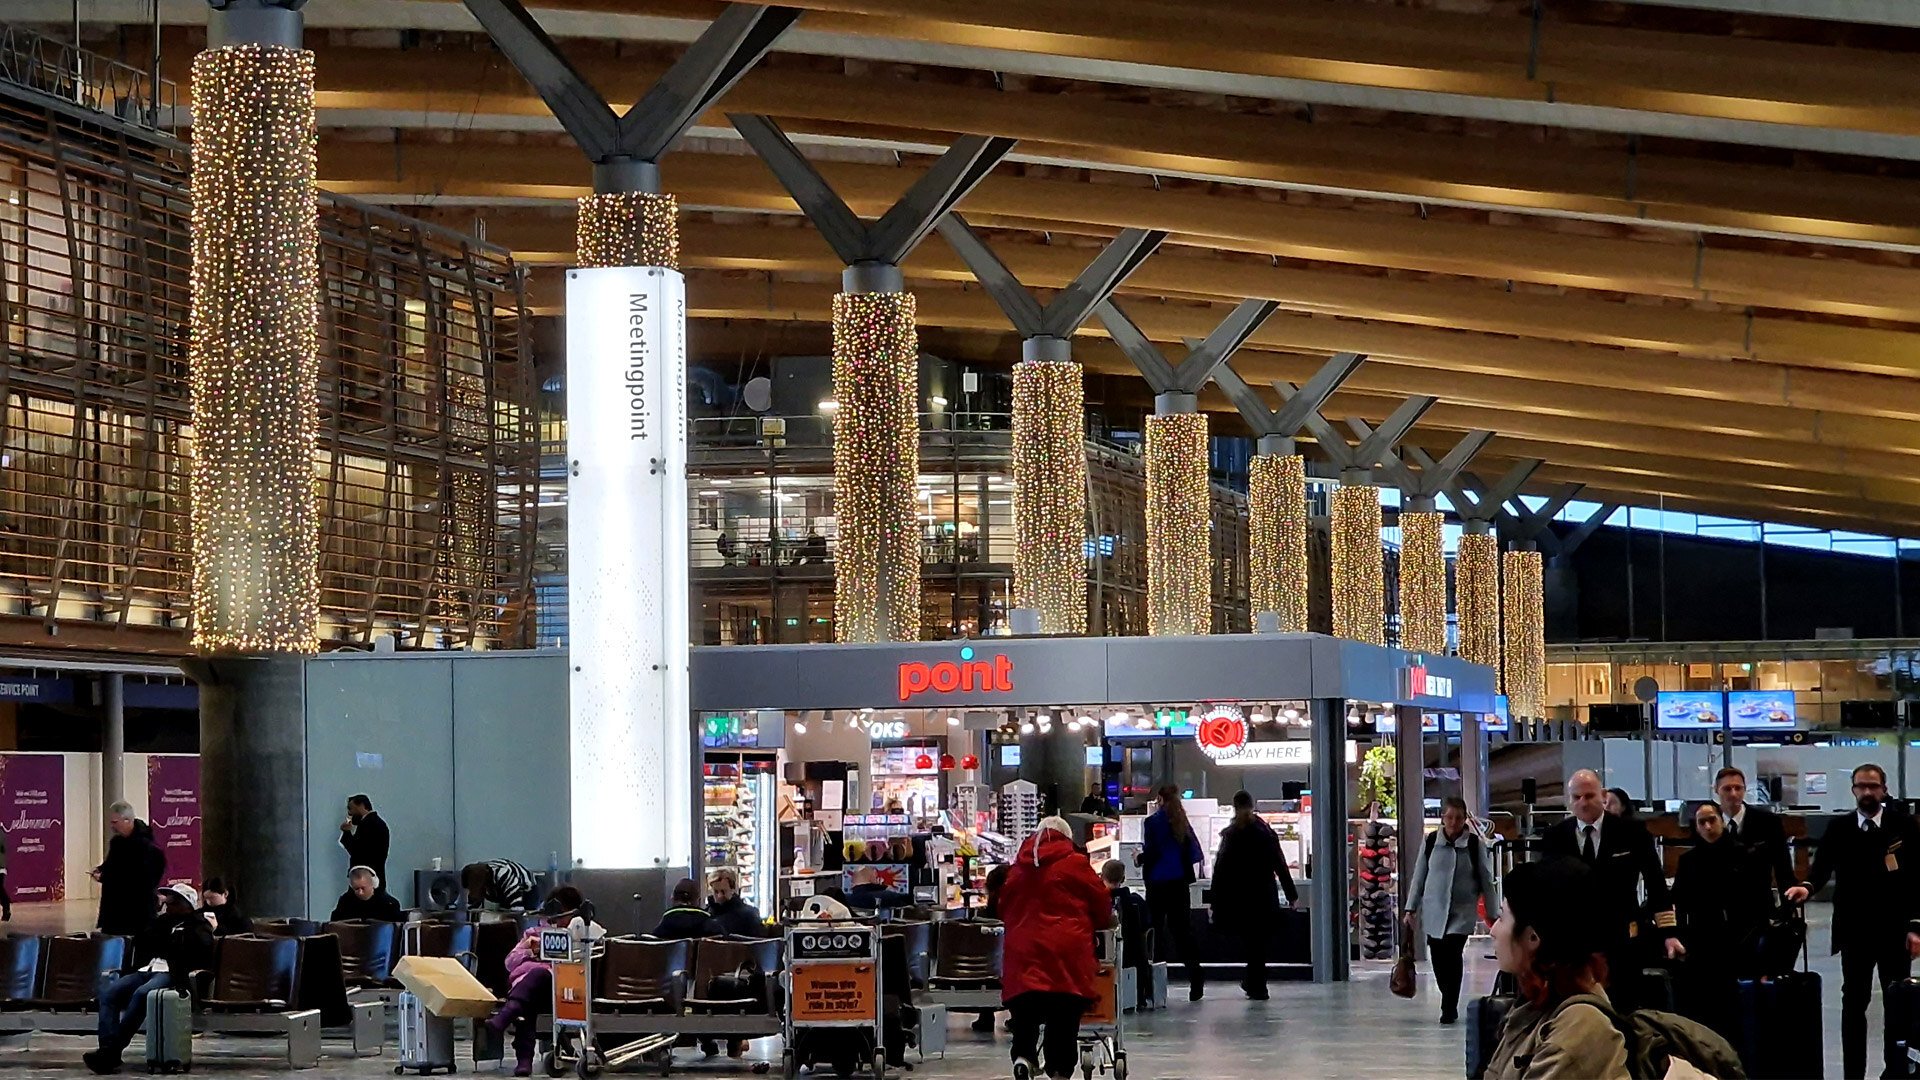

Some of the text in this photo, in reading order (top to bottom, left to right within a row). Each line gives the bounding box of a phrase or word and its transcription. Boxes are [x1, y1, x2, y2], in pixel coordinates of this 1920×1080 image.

[625, 293, 650, 441] Meetingpoint
[676, 299, 684, 443] Meetingpoint
[0, 683, 20, 696] ERVICE
[899, 646, 1013, 700] point
[1237, 747, 1302, 759] PAY HERE
